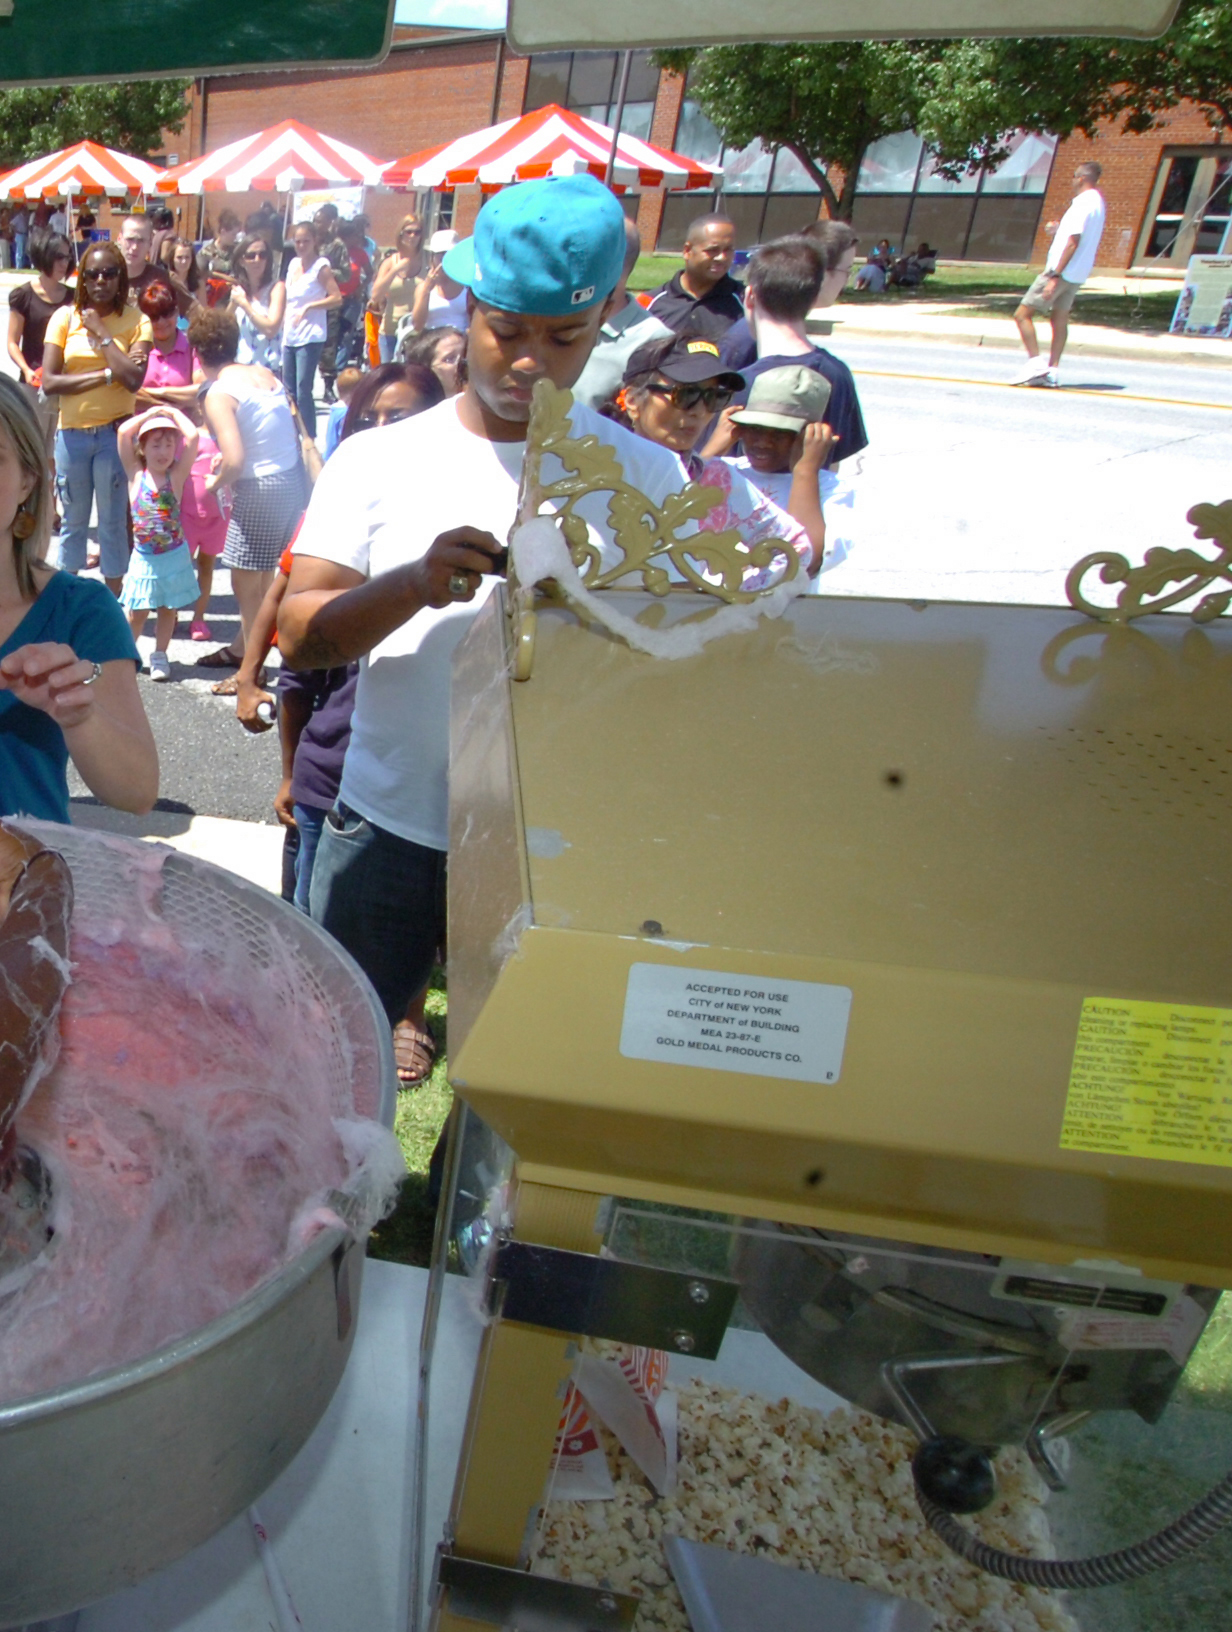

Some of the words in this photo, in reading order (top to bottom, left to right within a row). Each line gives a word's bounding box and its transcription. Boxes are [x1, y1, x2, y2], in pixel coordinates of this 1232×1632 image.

[686, 983, 740, 997] ACCEPTED
[744, 990, 765, 999] FOR
[769, 992, 789, 1002] USE
[689, 998, 711, 1007] CITY
[714, 1001, 723, 1009] of
[727, 1002, 749, 1012] NEW
[753, 1005, 782, 1016] YORK
[1083, 1006, 1130, 1017] CAUTION
[667, 1010, 735, 1024] DEPARTMENT
[739, 1019, 748, 1027] of
[751, 1020, 800, 1033] BUILDING
[1080, 1025, 1126, 1036] CAUTION
[701, 1029, 722, 1037] MEA
[725, 1031, 761, 1042] 23-87-E
[656, 1037, 684, 1047] GOLD
[687, 1041, 722, 1052] MEDAL
[726, 1046, 782, 1060] PRODUCTS
[785, 1053, 802, 1062] CO.
